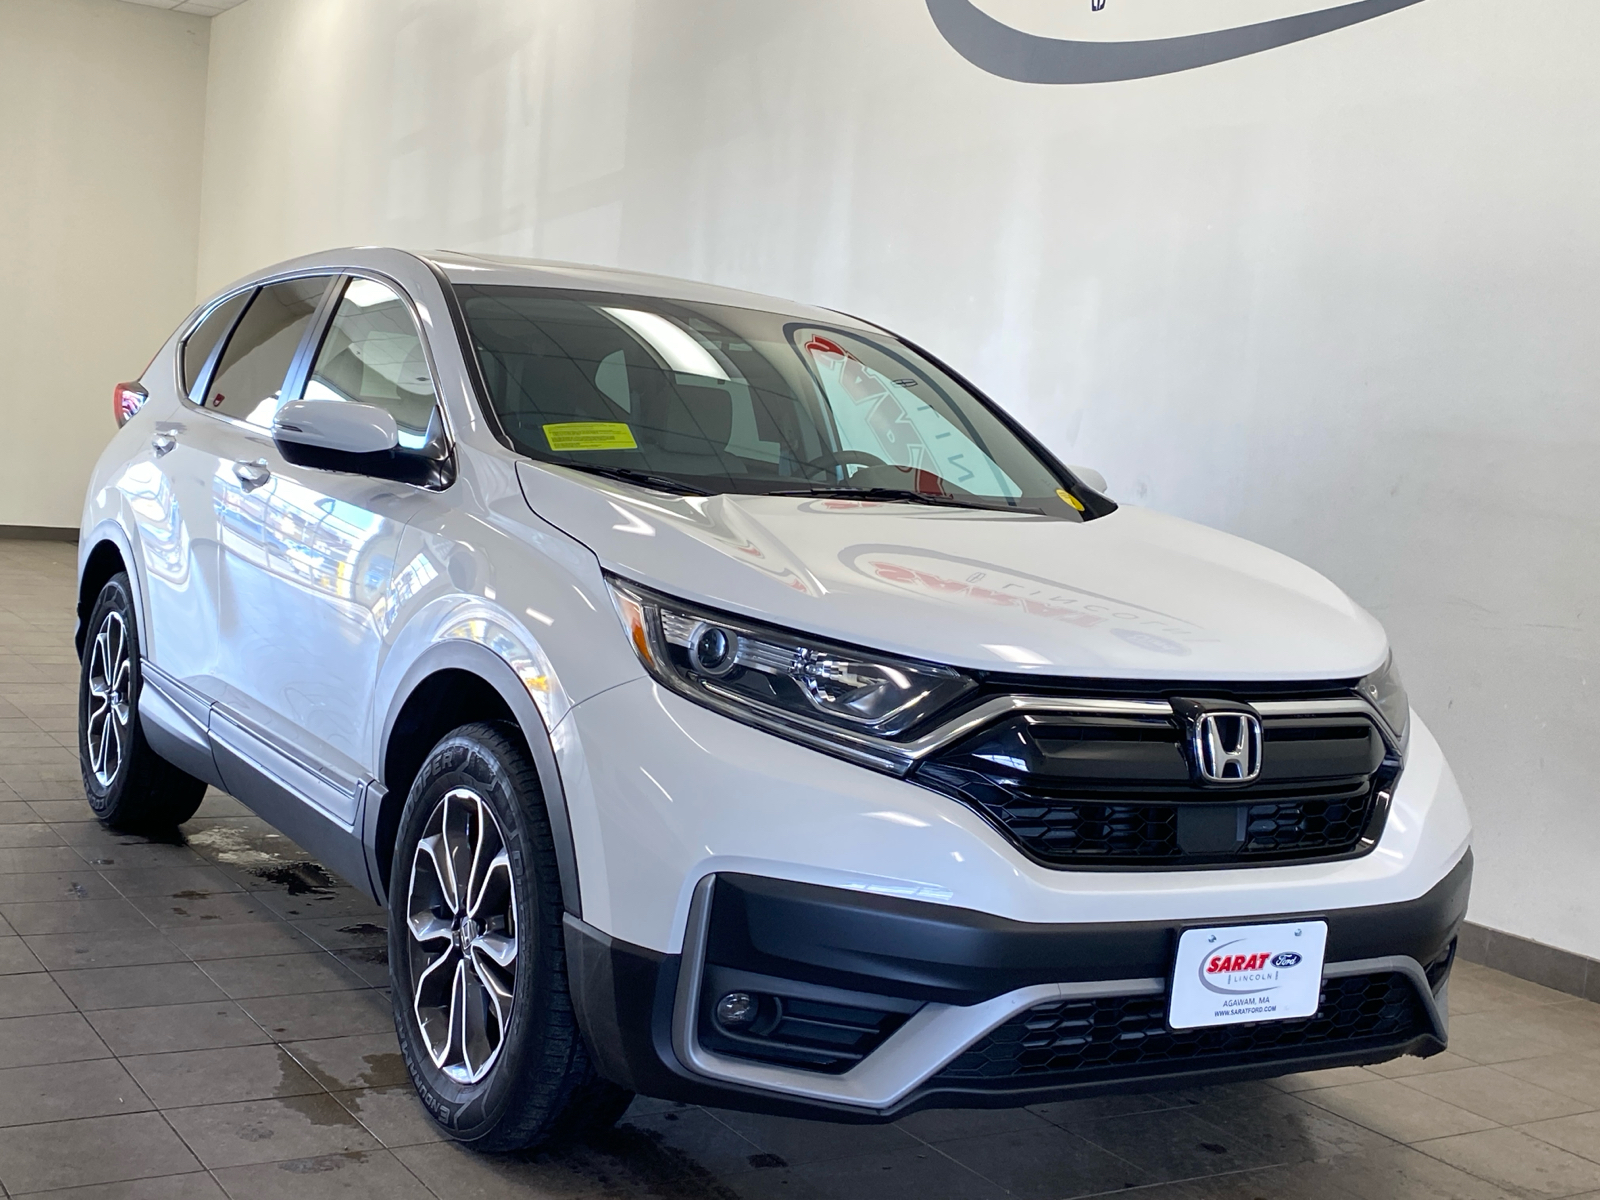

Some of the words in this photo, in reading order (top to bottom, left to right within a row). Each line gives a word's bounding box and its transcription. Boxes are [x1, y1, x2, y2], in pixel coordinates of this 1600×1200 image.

[1206, 952, 1272, 974] SARAT
[1275, 953, 1298, 967] Ford
[1233, 973, 1273, 982] LINCOLN
[1223, 998, 1257, 1007] AGAWAM,
[1258, 996, 1270, 1004] MA
[1214, 1005, 1277, 1017] WWW.SARATFORD.COM
